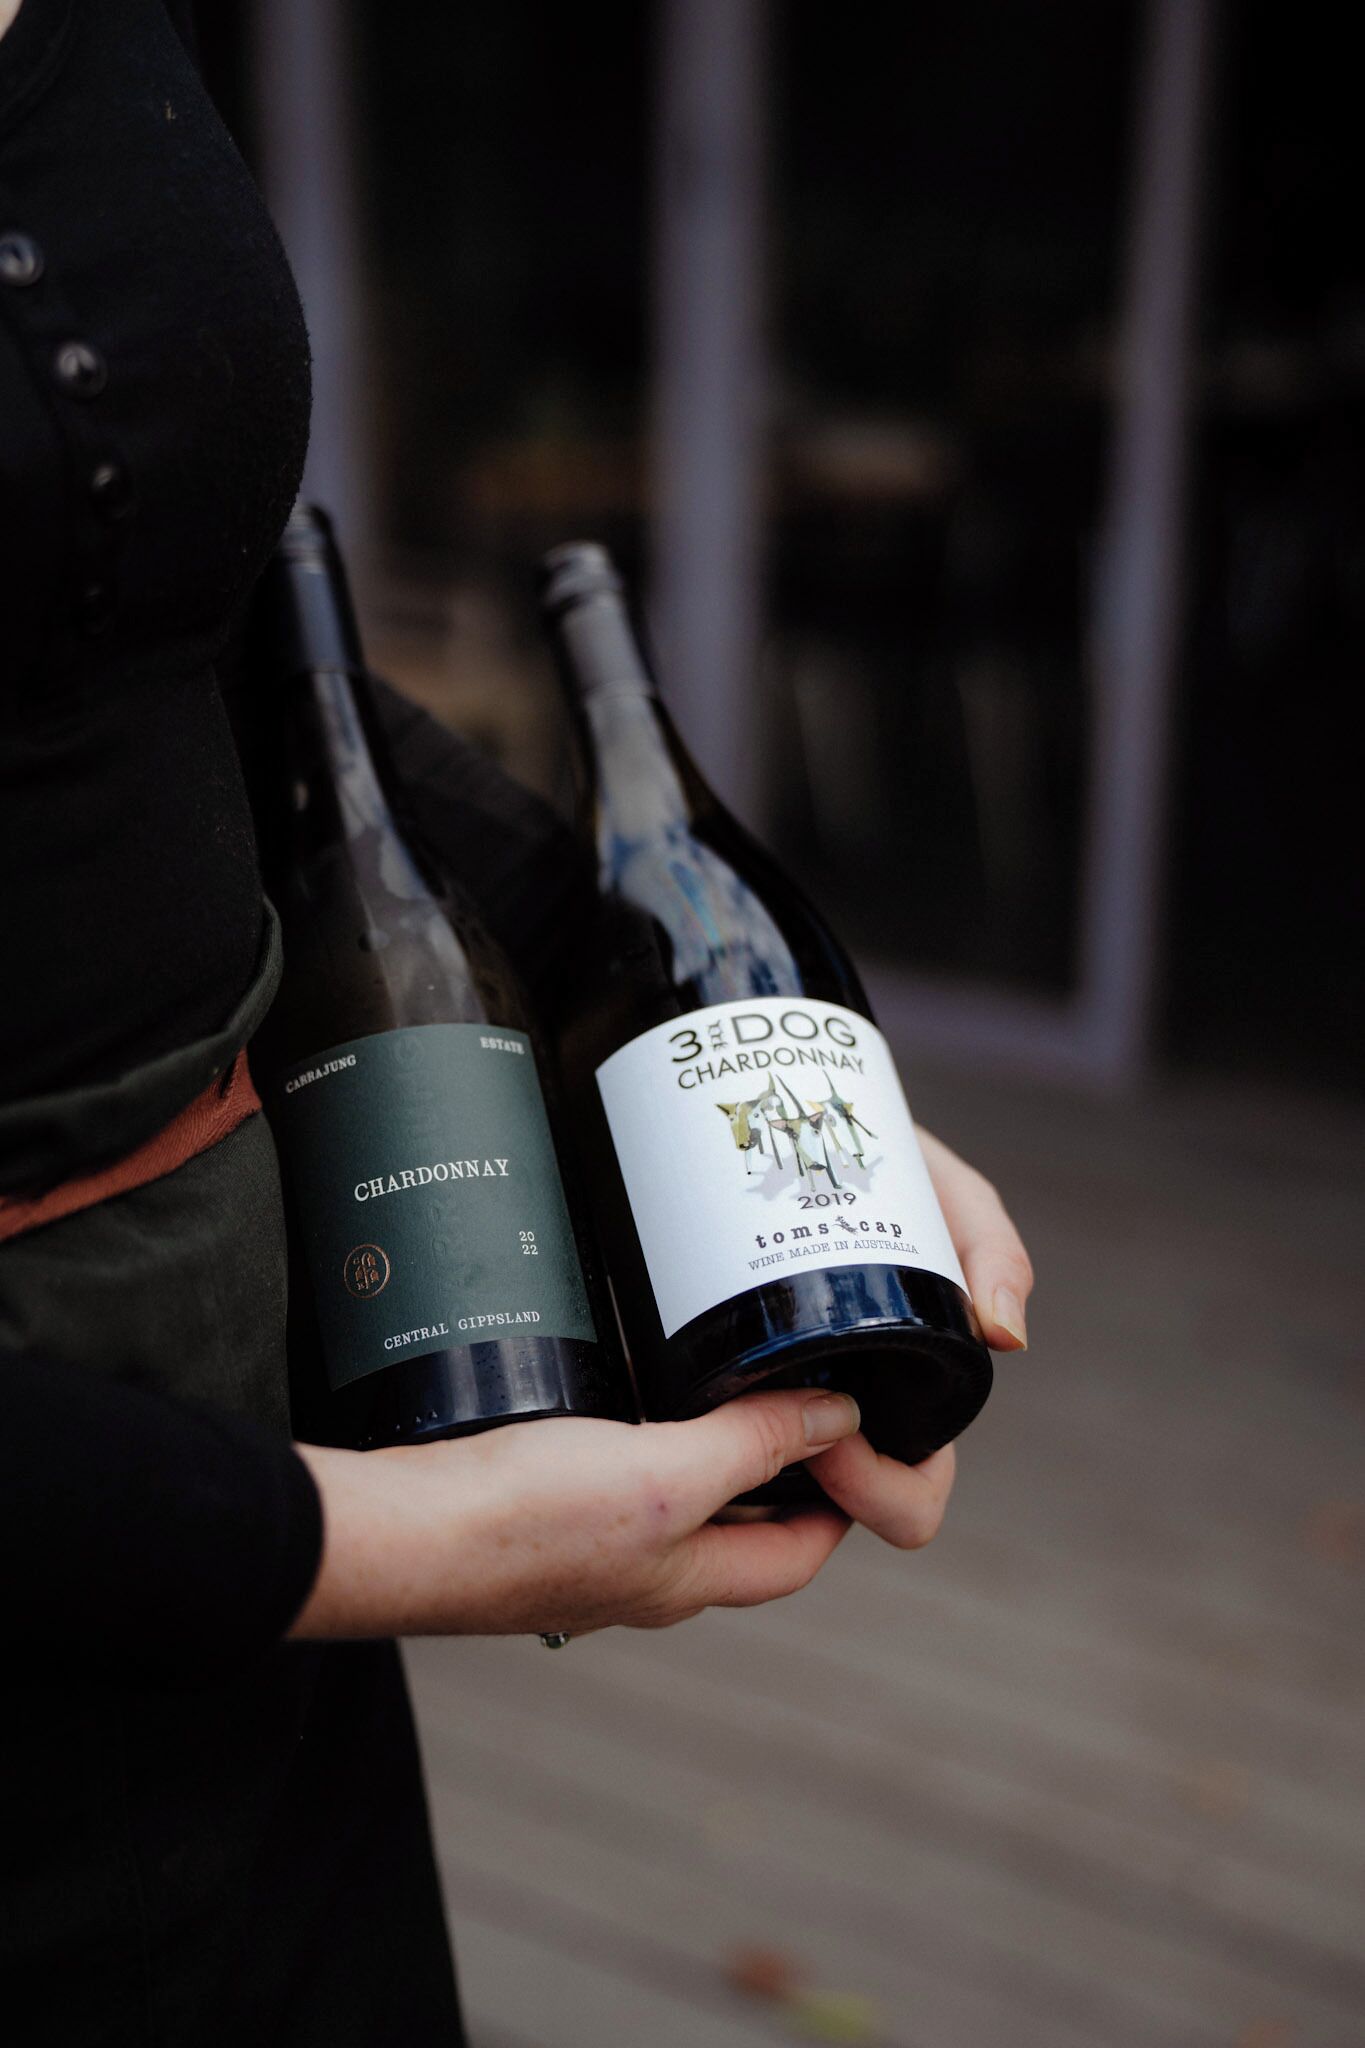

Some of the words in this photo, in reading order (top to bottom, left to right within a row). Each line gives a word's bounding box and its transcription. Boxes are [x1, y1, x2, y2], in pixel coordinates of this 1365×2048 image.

[669, 1030, 702, 1063] 3
[731, 1011, 856, 1047] DOG
[285, 1054, 357, 1094] CARRAJUNG
[480, 1036, 525, 1055] ESTATE
[678, 1047, 865, 1090] CHARDONNAY
[354, 1158, 509, 1202] CHARDONNAY
[798, 1192, 857, 1210] 2019
[518, 1231, 535, 1242] 20
[521, 1244, 539, 1255] 22
[755, 1221, 829, 1249] toms
[859, 1219, 903, 1239] cap
[748, 1252, 785, 1271] WINE
[789, 1242, 831, 1260] MADE
[835, 1240, 850, 1251] IN
[853, 1239, 920, 1255] AUSTRALIA
[383, 1322, 449, 1350] CENTRAL
[457, 1310, 541, 1330] GIPPSLAND
